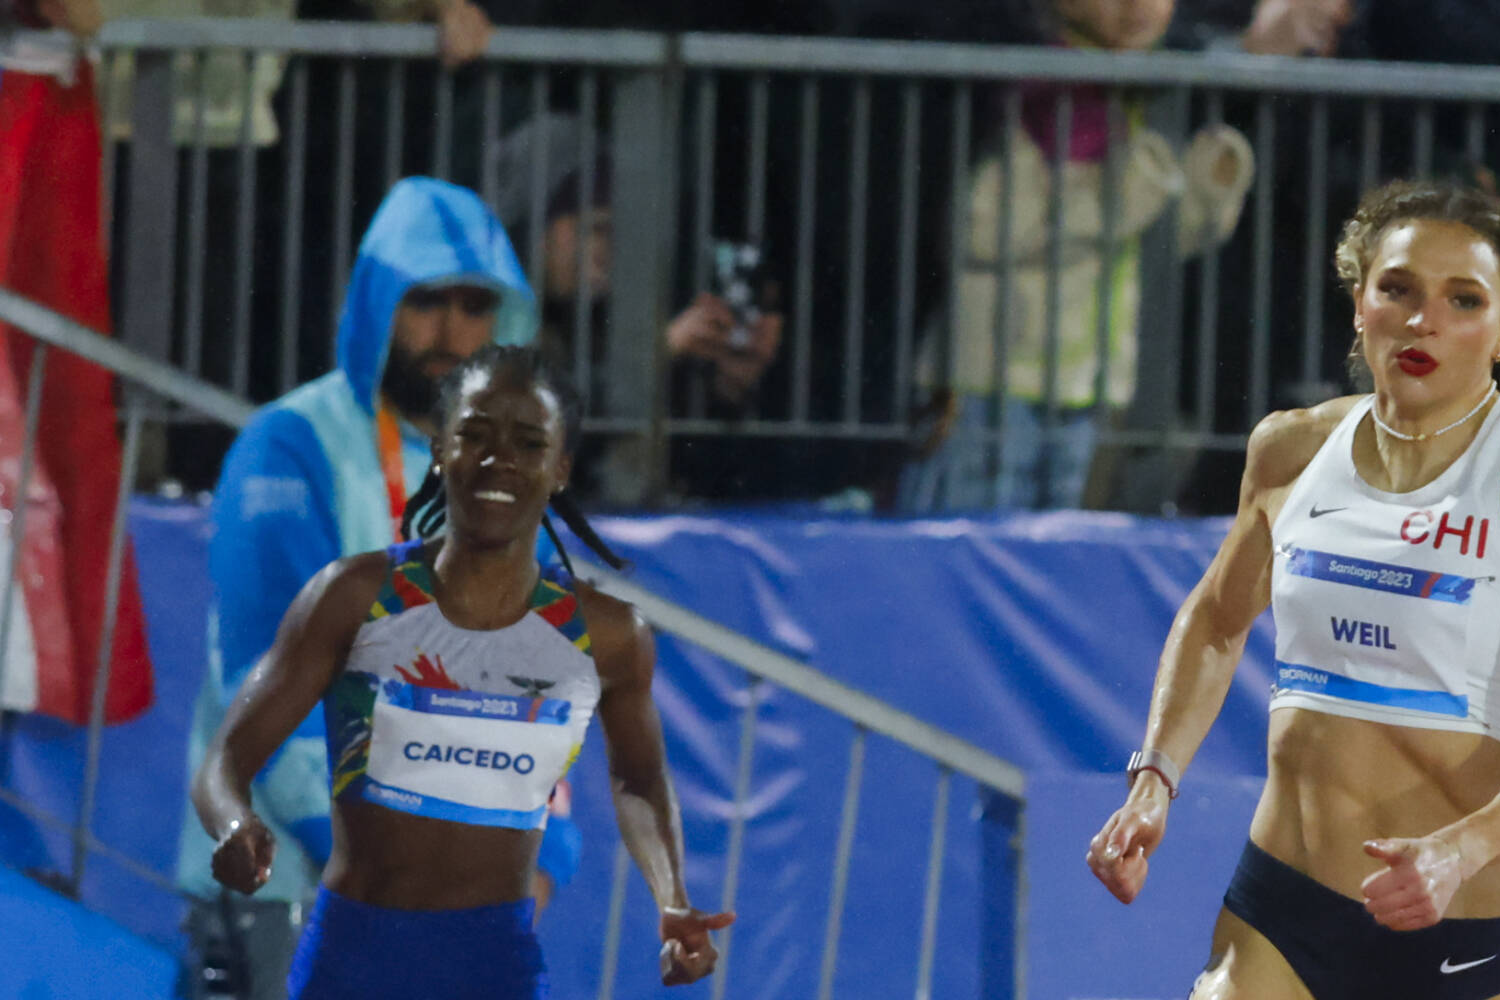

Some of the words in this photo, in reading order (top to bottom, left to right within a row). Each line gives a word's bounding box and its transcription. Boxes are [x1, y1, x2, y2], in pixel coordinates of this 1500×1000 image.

[1400, 510, 1489, 559] CHI
[1328, 560, 1378, 581] Santiago
[1377, 569, 1413, 589] 2023
[1331, 616, 1397, 650] WEIL
[403, 741, 536, 775] CAICEDO
